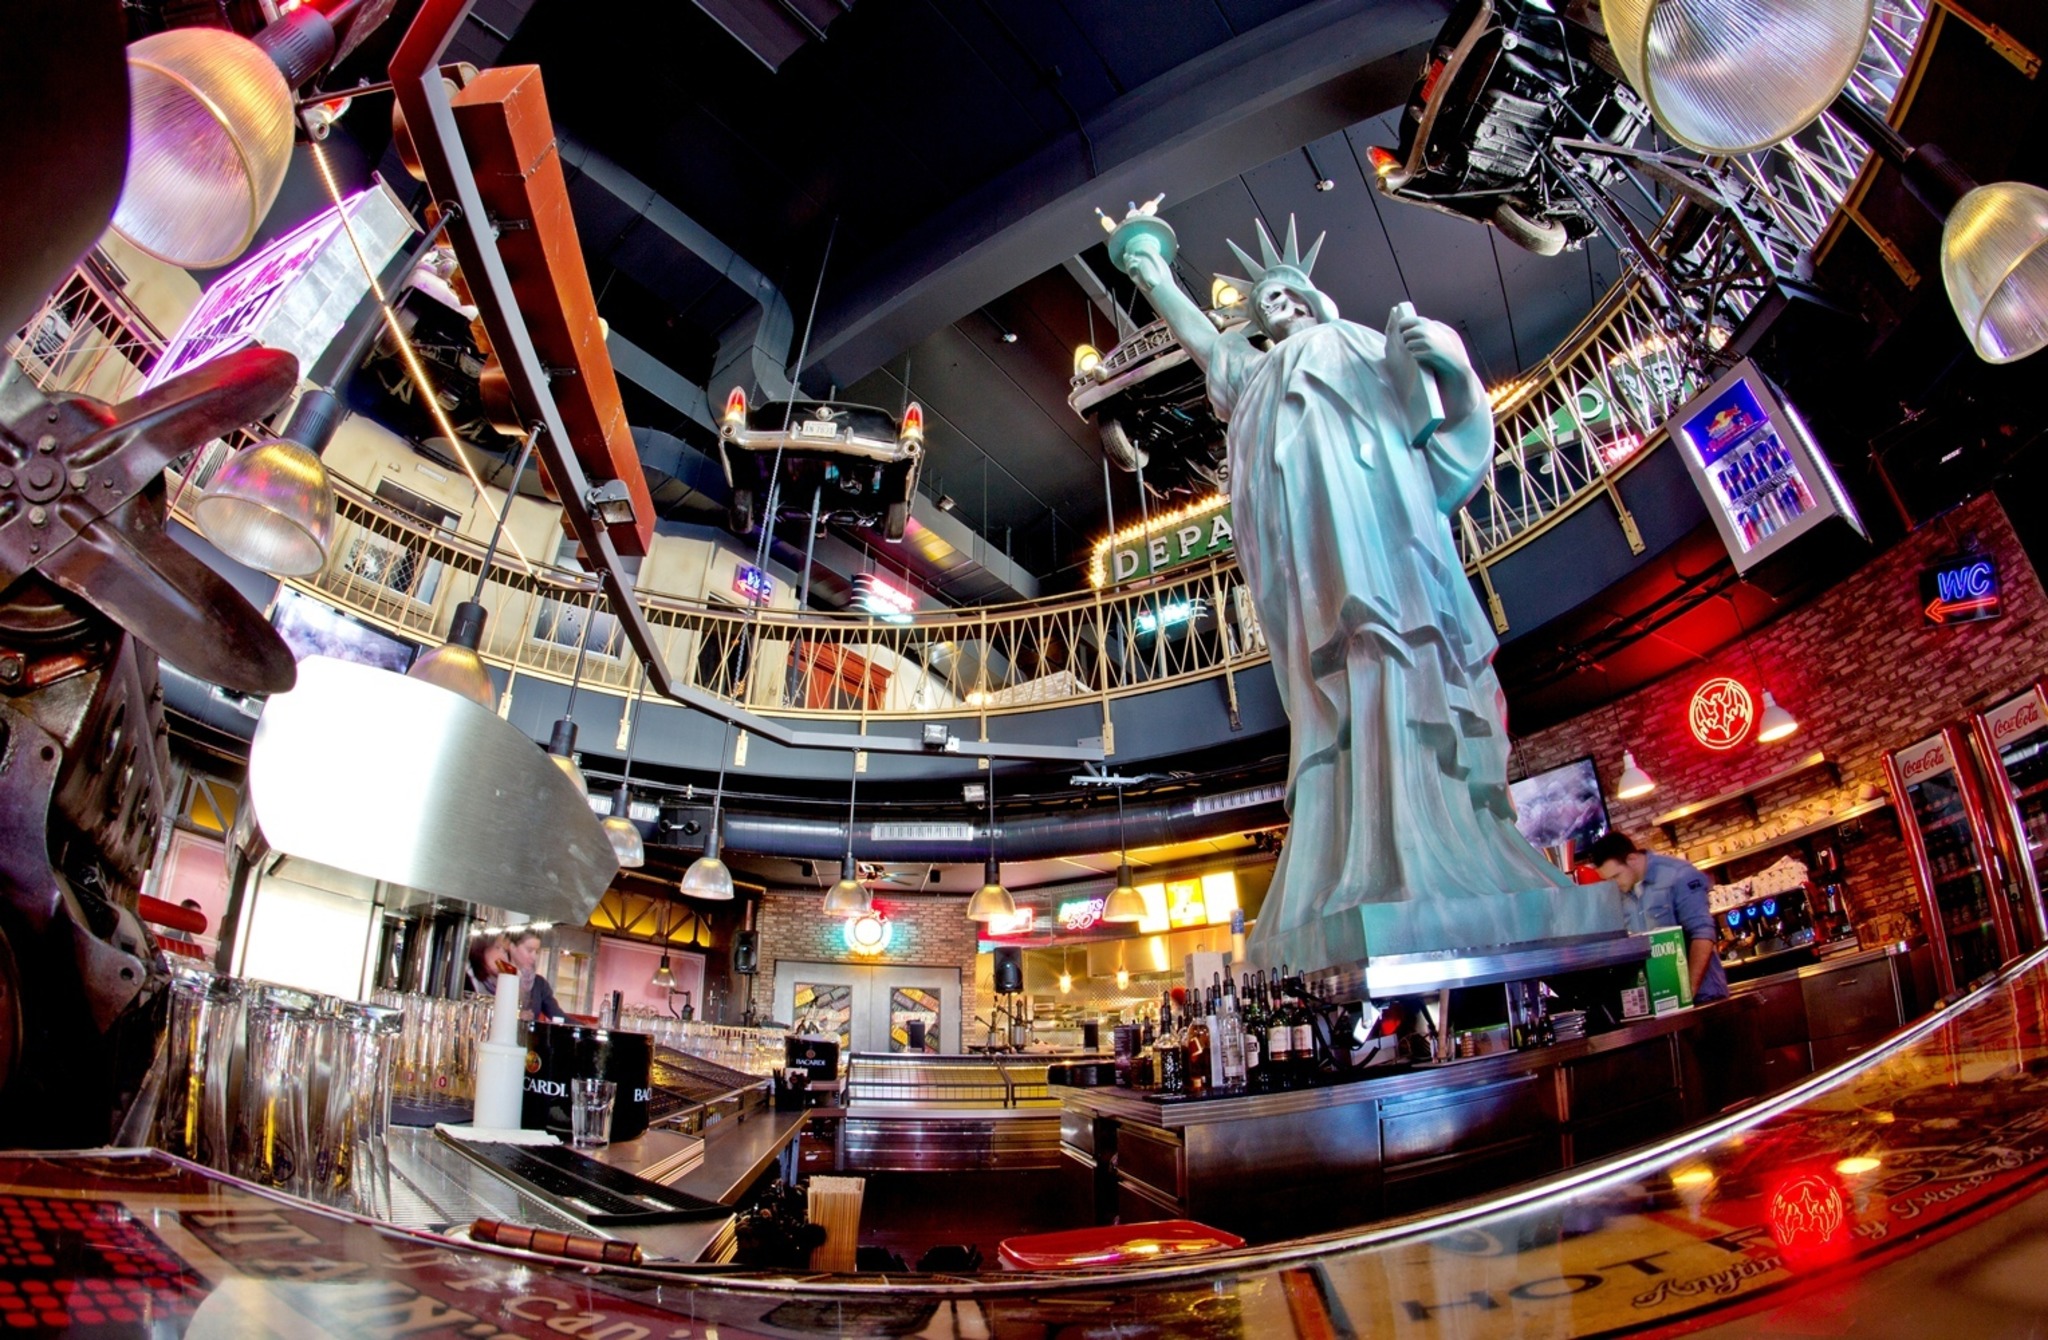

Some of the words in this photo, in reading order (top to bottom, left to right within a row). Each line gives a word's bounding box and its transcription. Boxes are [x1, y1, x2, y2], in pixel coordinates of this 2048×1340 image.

[165, 279, 285, 379] MARKET
[1937, 562, 1990, 602] WC
[1993, 701, 2039, 739] Coca-Cola
[1903, 745, 1945, 779] Coca-Cola
[523, 1076, 568, 1098] CARDI
